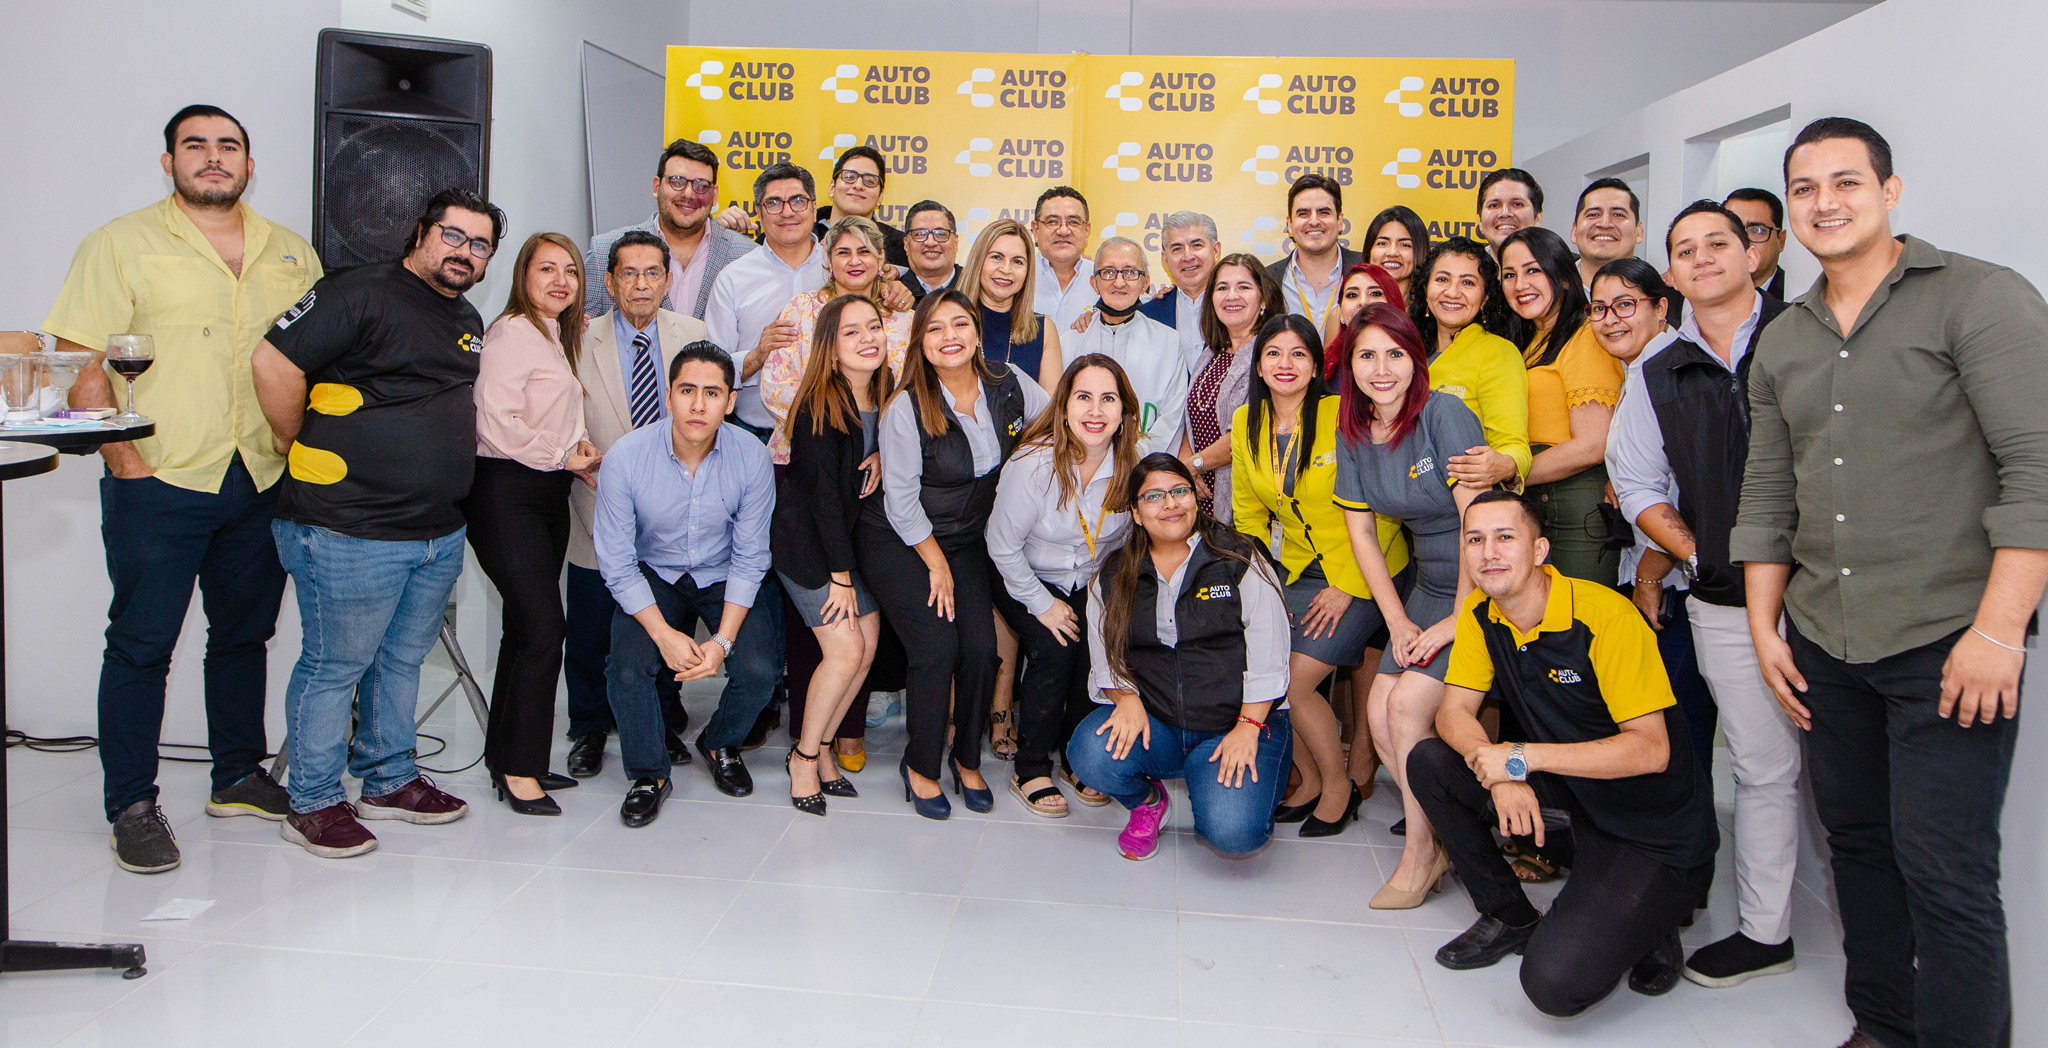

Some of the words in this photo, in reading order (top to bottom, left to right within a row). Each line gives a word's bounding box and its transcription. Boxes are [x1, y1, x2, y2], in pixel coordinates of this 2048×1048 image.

[729, 62, 794, 79] AUTO
[865, 66, 930, 83] AUTO
[1001, 69, 1067, 87] AUTO
[1149, 72, 1216, 90] AUTO
[1288, 75, 1356, 93] AUTO
[1430, 78, 1500, 95] AUTO
[729, 81, 794, 101] CLUB
[864, 85, 930, 104] CLUB
[1000, 89, 1066, 109] CLUB
[1148, 92, 1215, 112] CLUB
[1287, 95, 1355, 115] CLUB
[1429, 98, 1499, 118] CLUB
[727, 131, 792, 149] AUTO
[864, 134, 928, 153] AUTO
[998, 138, 1064, 157] AUTO
[1147, 143, 1214, 161] AUTO
[1285, 146, 1354, 164] AUTO
[1427, 149, 1497, 168] AUTO
[881, 155, 928, 174] LUB
[998, 158, 1064, 179] CLUB
[1146, 162, 1213, 183] CLUB
[1446, 384, 1467, 393] AUTO
[1323, 450, 1337, 460] AUT
[1210, 591, 1232, 599] CLUB
[1559, 675, 1582, 684] CLUB
